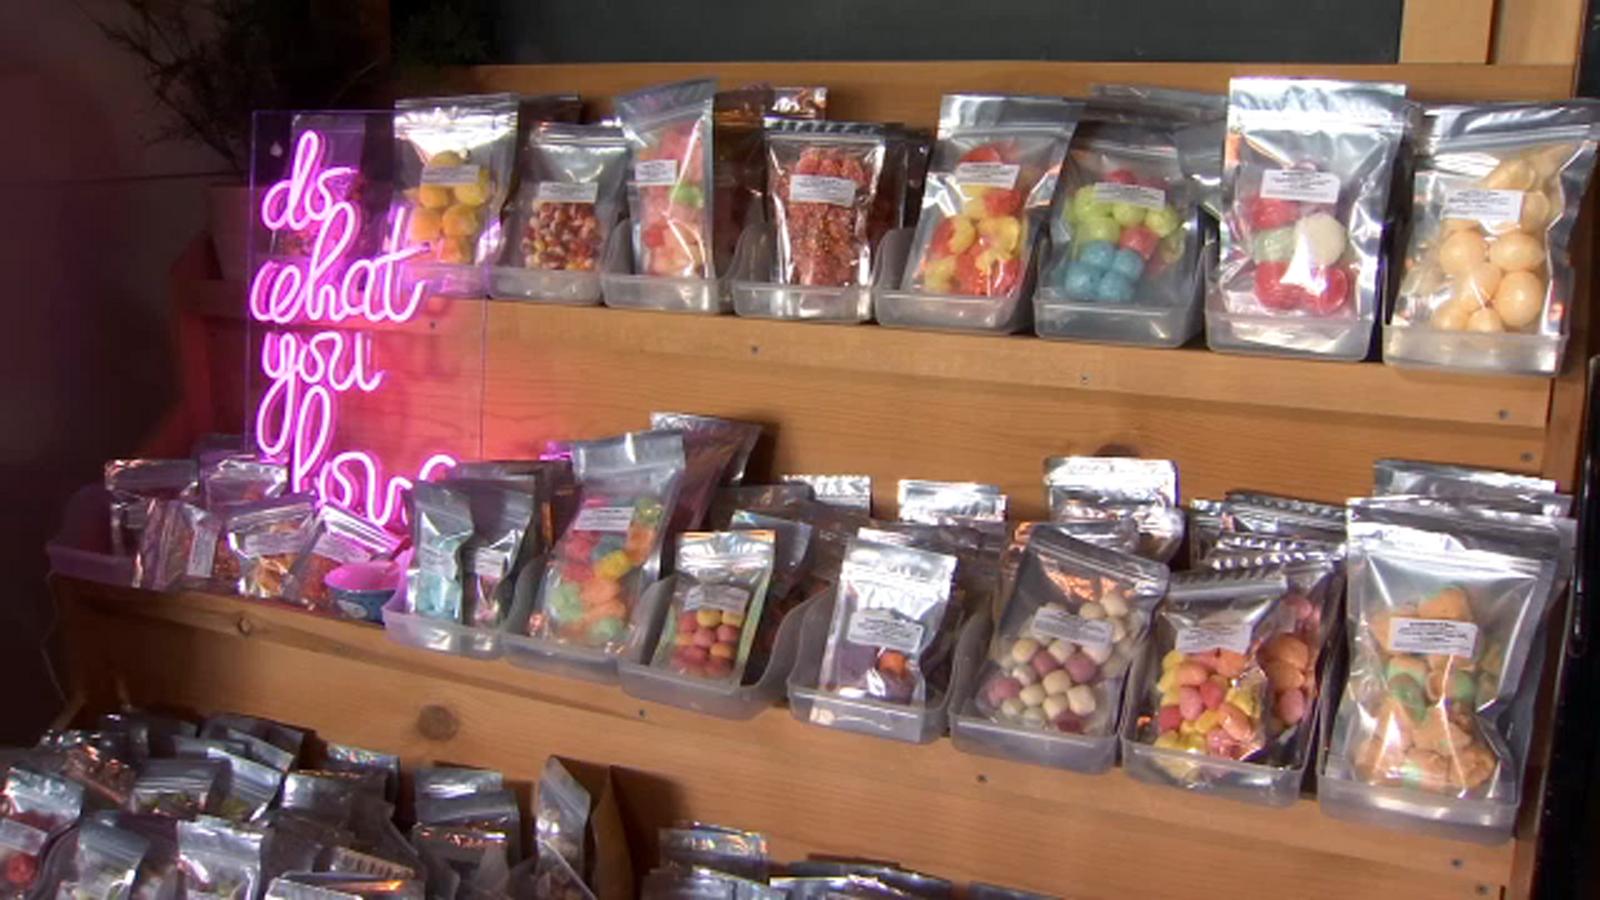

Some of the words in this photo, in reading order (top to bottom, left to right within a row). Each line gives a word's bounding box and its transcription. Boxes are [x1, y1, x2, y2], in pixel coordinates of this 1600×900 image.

[261, 131, 356, 230] do
[250, 202, 428, 323] what
[256, 332, 386, 456] you
